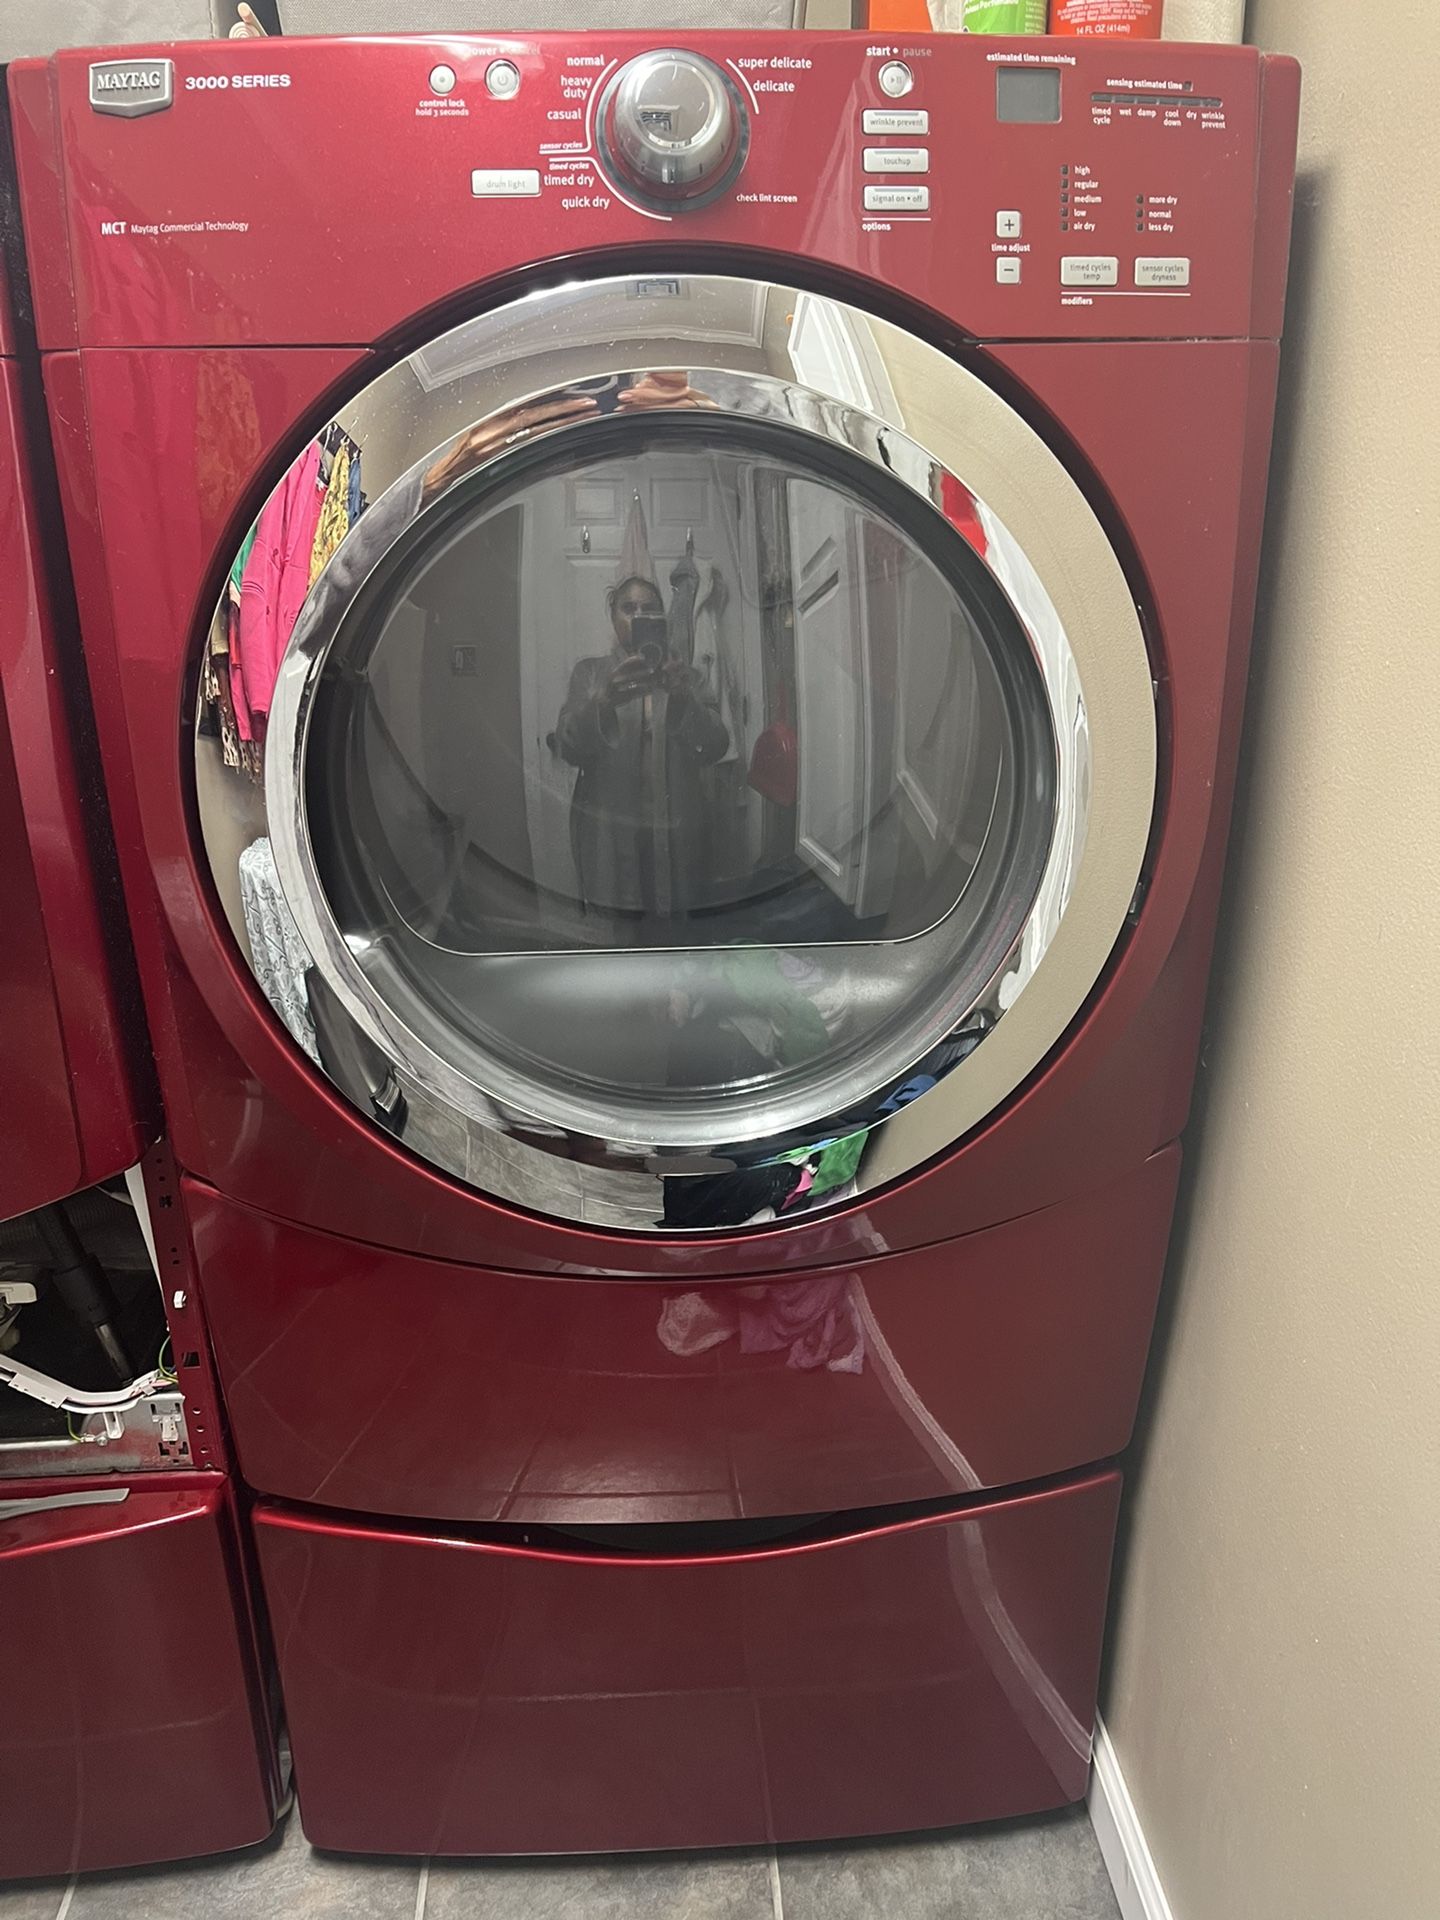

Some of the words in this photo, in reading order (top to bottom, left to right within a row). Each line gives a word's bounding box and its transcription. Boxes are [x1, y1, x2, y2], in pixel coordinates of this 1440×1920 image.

[866, 46, 891, 57] start
[902, 47, 932, 59] pause
[567, 54, 605, 66] normal
[738, 57, 768, 70] super
[770, 57, 812, 69] delicate
[986, 52, 1023, 62] estimated
[1023, 53, 1040, 63] time
[1041, 54, 1076, 65] remaining
[97, 71, 160, 90] MAYTAG
[185, 76, 228, 89] 3000
[231, 74, 291, 88] SERIES
[560, 75, 592, 88] heavy
[1106, 78, 1133, 89] sensing
[1134, 79, 1167, 90] estimated
[1167, 80, 1183, 90] time
[753, 80, 795, 92] delicate
[563, 87, 588, 99] duty
[419, 99, 448, 108] control
[448, 99, 465, 108] lock
[415, 108, 432, 117] hold
[433, 110, 439, 118] 3
[439, 108, 469, 117] seconds
[547, 109, 582, 120] casual
[1091, 107, 1112, 116] timed
[1119, 108, 1132, 117] wet
[1137, 107, 1157, 118] damp
[1164, 110, 1179, 119] cool
[1186, 110, 1197, 120] dry
[1201, 112, 1225, 121] wrinkle
[870, 118, 895, 127] wrinkle
[897, 118, 924, 128] prevent
[1093, 116, 1111, 126] cycle
[1163, 118, 1182, 127] down
[1201, 120, 1226, 130] prevent
[562, 141, 583, 150] cycles
[549, 162, 568, 171] timed
[569, 162, 589, 171] cycles
[883, 157, 912, 167] touchup
[1074, 166, 1091, 176] high
[486, 179, 507, 188] drum
[508, 179, 526, 190] light
[543, 174, 575, 186] timed
[577, 174, 594, 187] dry
[1074, 180, 1099, 191] regular
[561, 197, 591, 209] quick
[592, 196, 610, 209] dry
[736, 194, 758, 202] check
[758, 194, 772, 202] lint
[772, 195, 798, 203] screen
[872, 194, 894, 204] signal
[913, 194, 923, 203] off
[1074, 194, 1102, 203] medium
[1149, 196, 1166, 204] more
[1167, 195, 1178, 206] dry
[1074, 209, 1087, 218] low
[1148, 210, 1172, 219] normal
[101, 221, 127, 235] MCT
[131, 223, 158, 235] Maytag
[160, 222, 204, 233] Commercial
[205, 220, 249, 232] Technology
[862, 222, 891, 231] options
[1073, 222, 1083, 231] air
[1084, 222, 1095, 232] dry
[1148, 223, 1163, 231] less
[1163, 223, 1174, 233] dry
[991, 243, 1008, 252] time
[1009, 243, 1030, 254] adjust
[1070, 263, 1090, 272] timed
[1091, 264, 1111, 274] cycles
[1142, 265, 1163, 273] sensor
[1164, 264, 1184, 274] cycles
[1083, 273, 1101, 282] temp
[1151, 273, 1176, 282] dryness
[1061, 296, 1093, 305] modifiers
